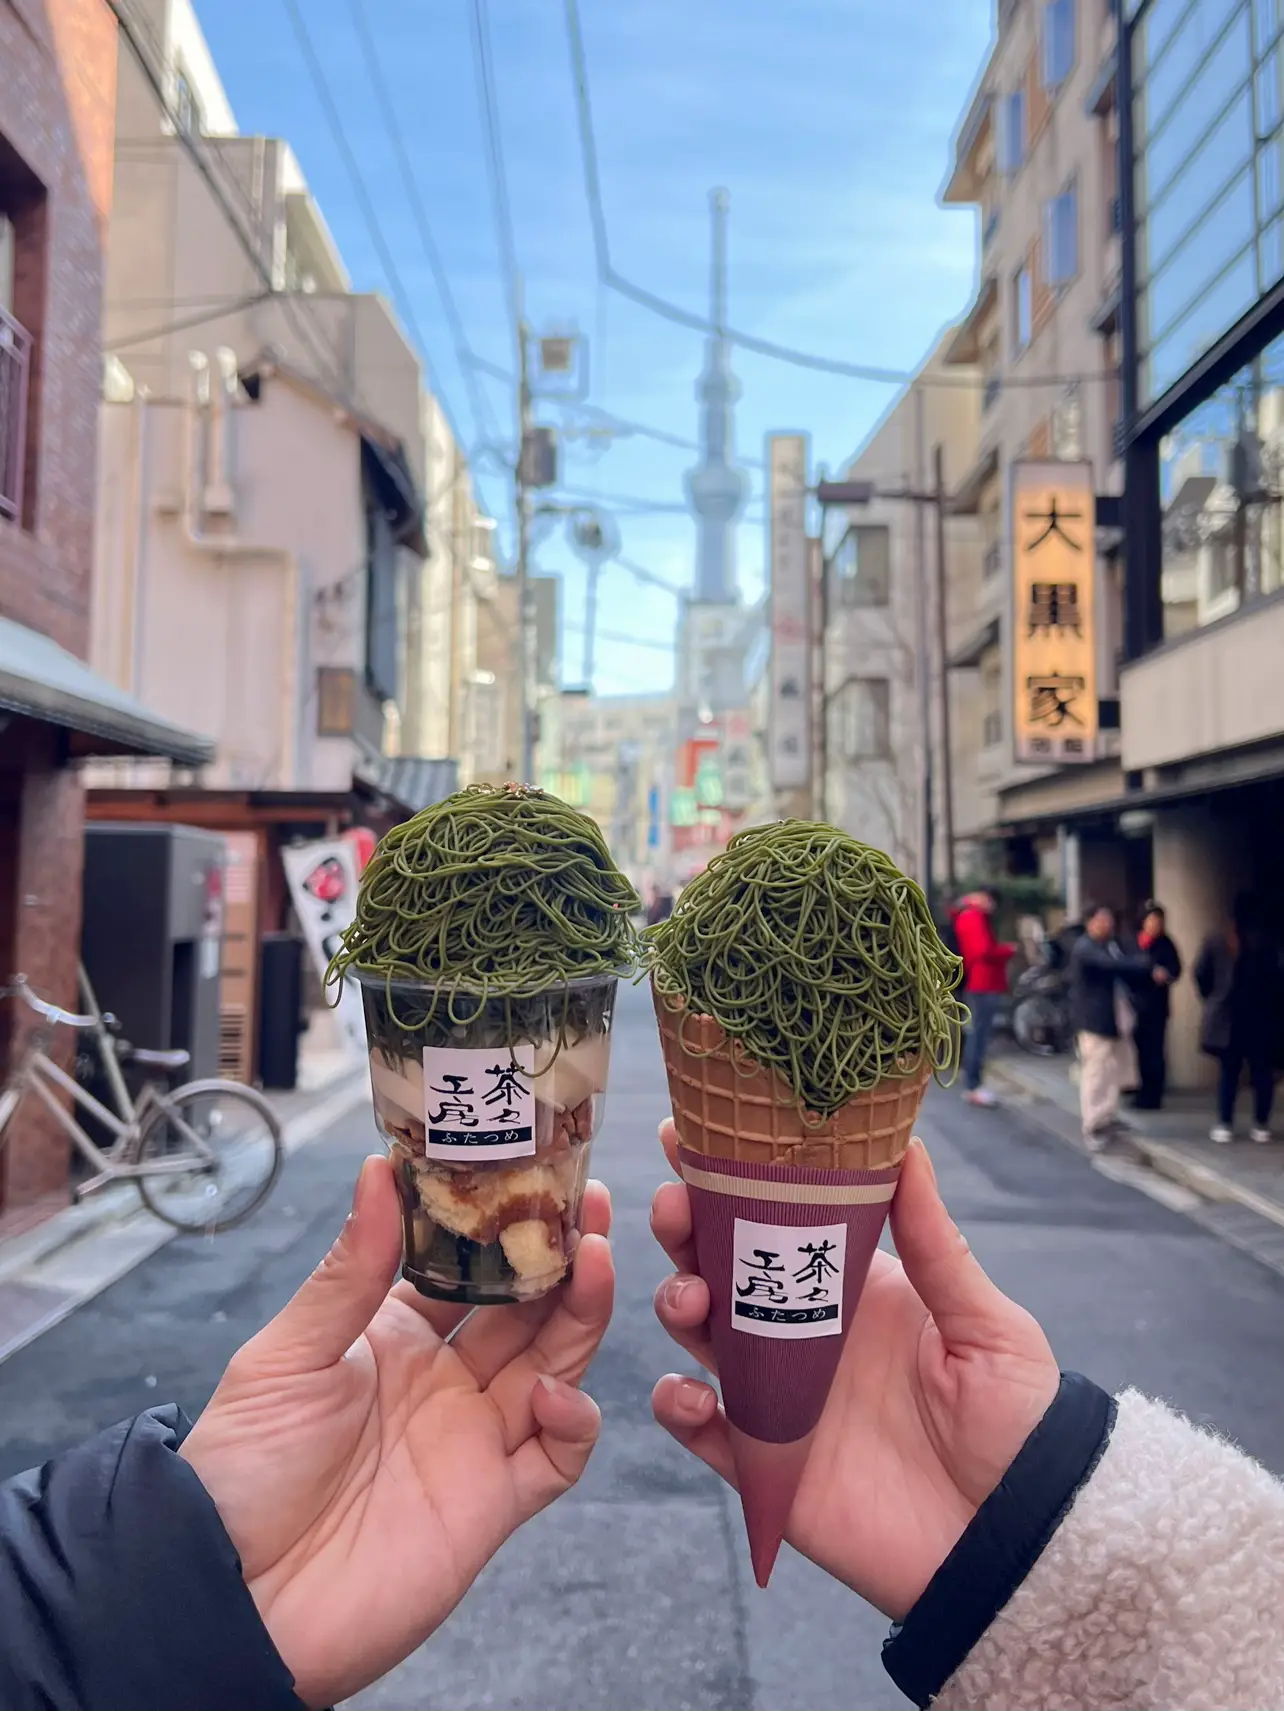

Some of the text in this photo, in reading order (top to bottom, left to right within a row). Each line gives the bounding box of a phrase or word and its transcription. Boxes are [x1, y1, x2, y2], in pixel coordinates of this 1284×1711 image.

[428, 1074, 479, 1127] 工房
[442, 1130, 519, 1144] ふたつめ
[735, 1249, 788, 1304] 工房
[748, 1307, 826, 1322] ふたつめ
